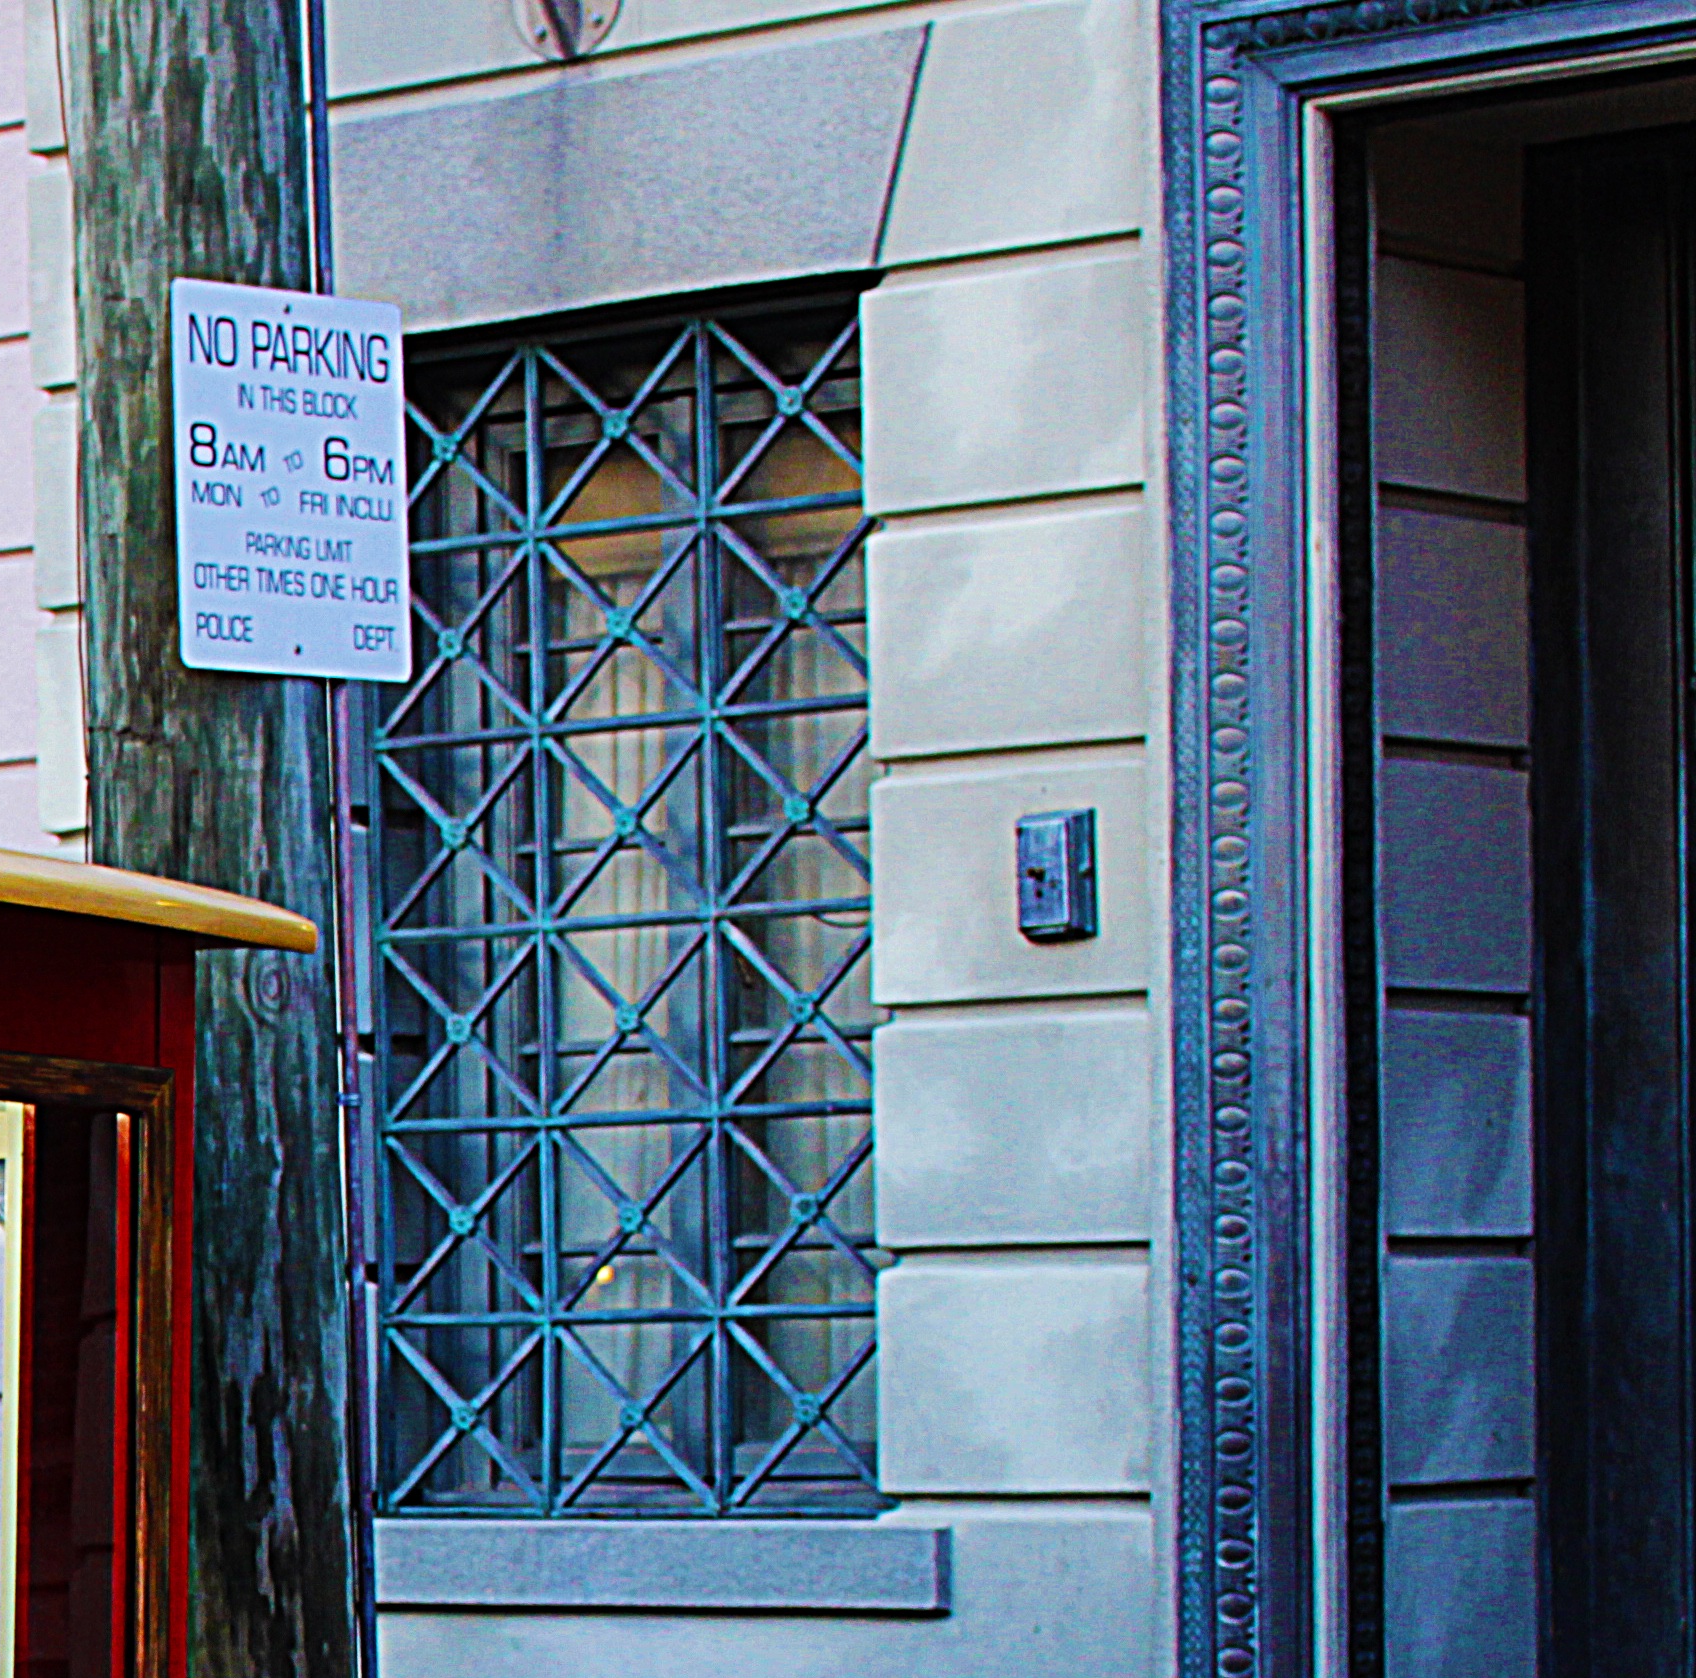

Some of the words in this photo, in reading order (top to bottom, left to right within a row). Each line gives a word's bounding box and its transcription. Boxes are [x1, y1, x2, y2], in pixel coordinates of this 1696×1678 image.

[189, 313, 238, 367] NO
[252, 319, 390, 383] PARKING
[238, 383, 254, 410] IN
[261, 385, 297, 414] THIS
[303, 388, 357, 420] BLOCK
[190, 421, 266, 473] 8AM
[283, 449, 304, 473] TO
[324, 437, 396, 485] 6PM
[192, 480, 242, 507] MON
[260, 485, 281, 508] TO
[300, 489, 329, 516] FRI
[245, 531, 311, 560] PARKING
[316, 537, 353, 562] LIMIT
[194, 562, 250, 592] OTHER
[256, 566, 306, 597] TIMES
[311, 571, 345, 600] ONE
[351, 575, 398, 604] HOUR
[196, 611, 254, 643] POLICE
